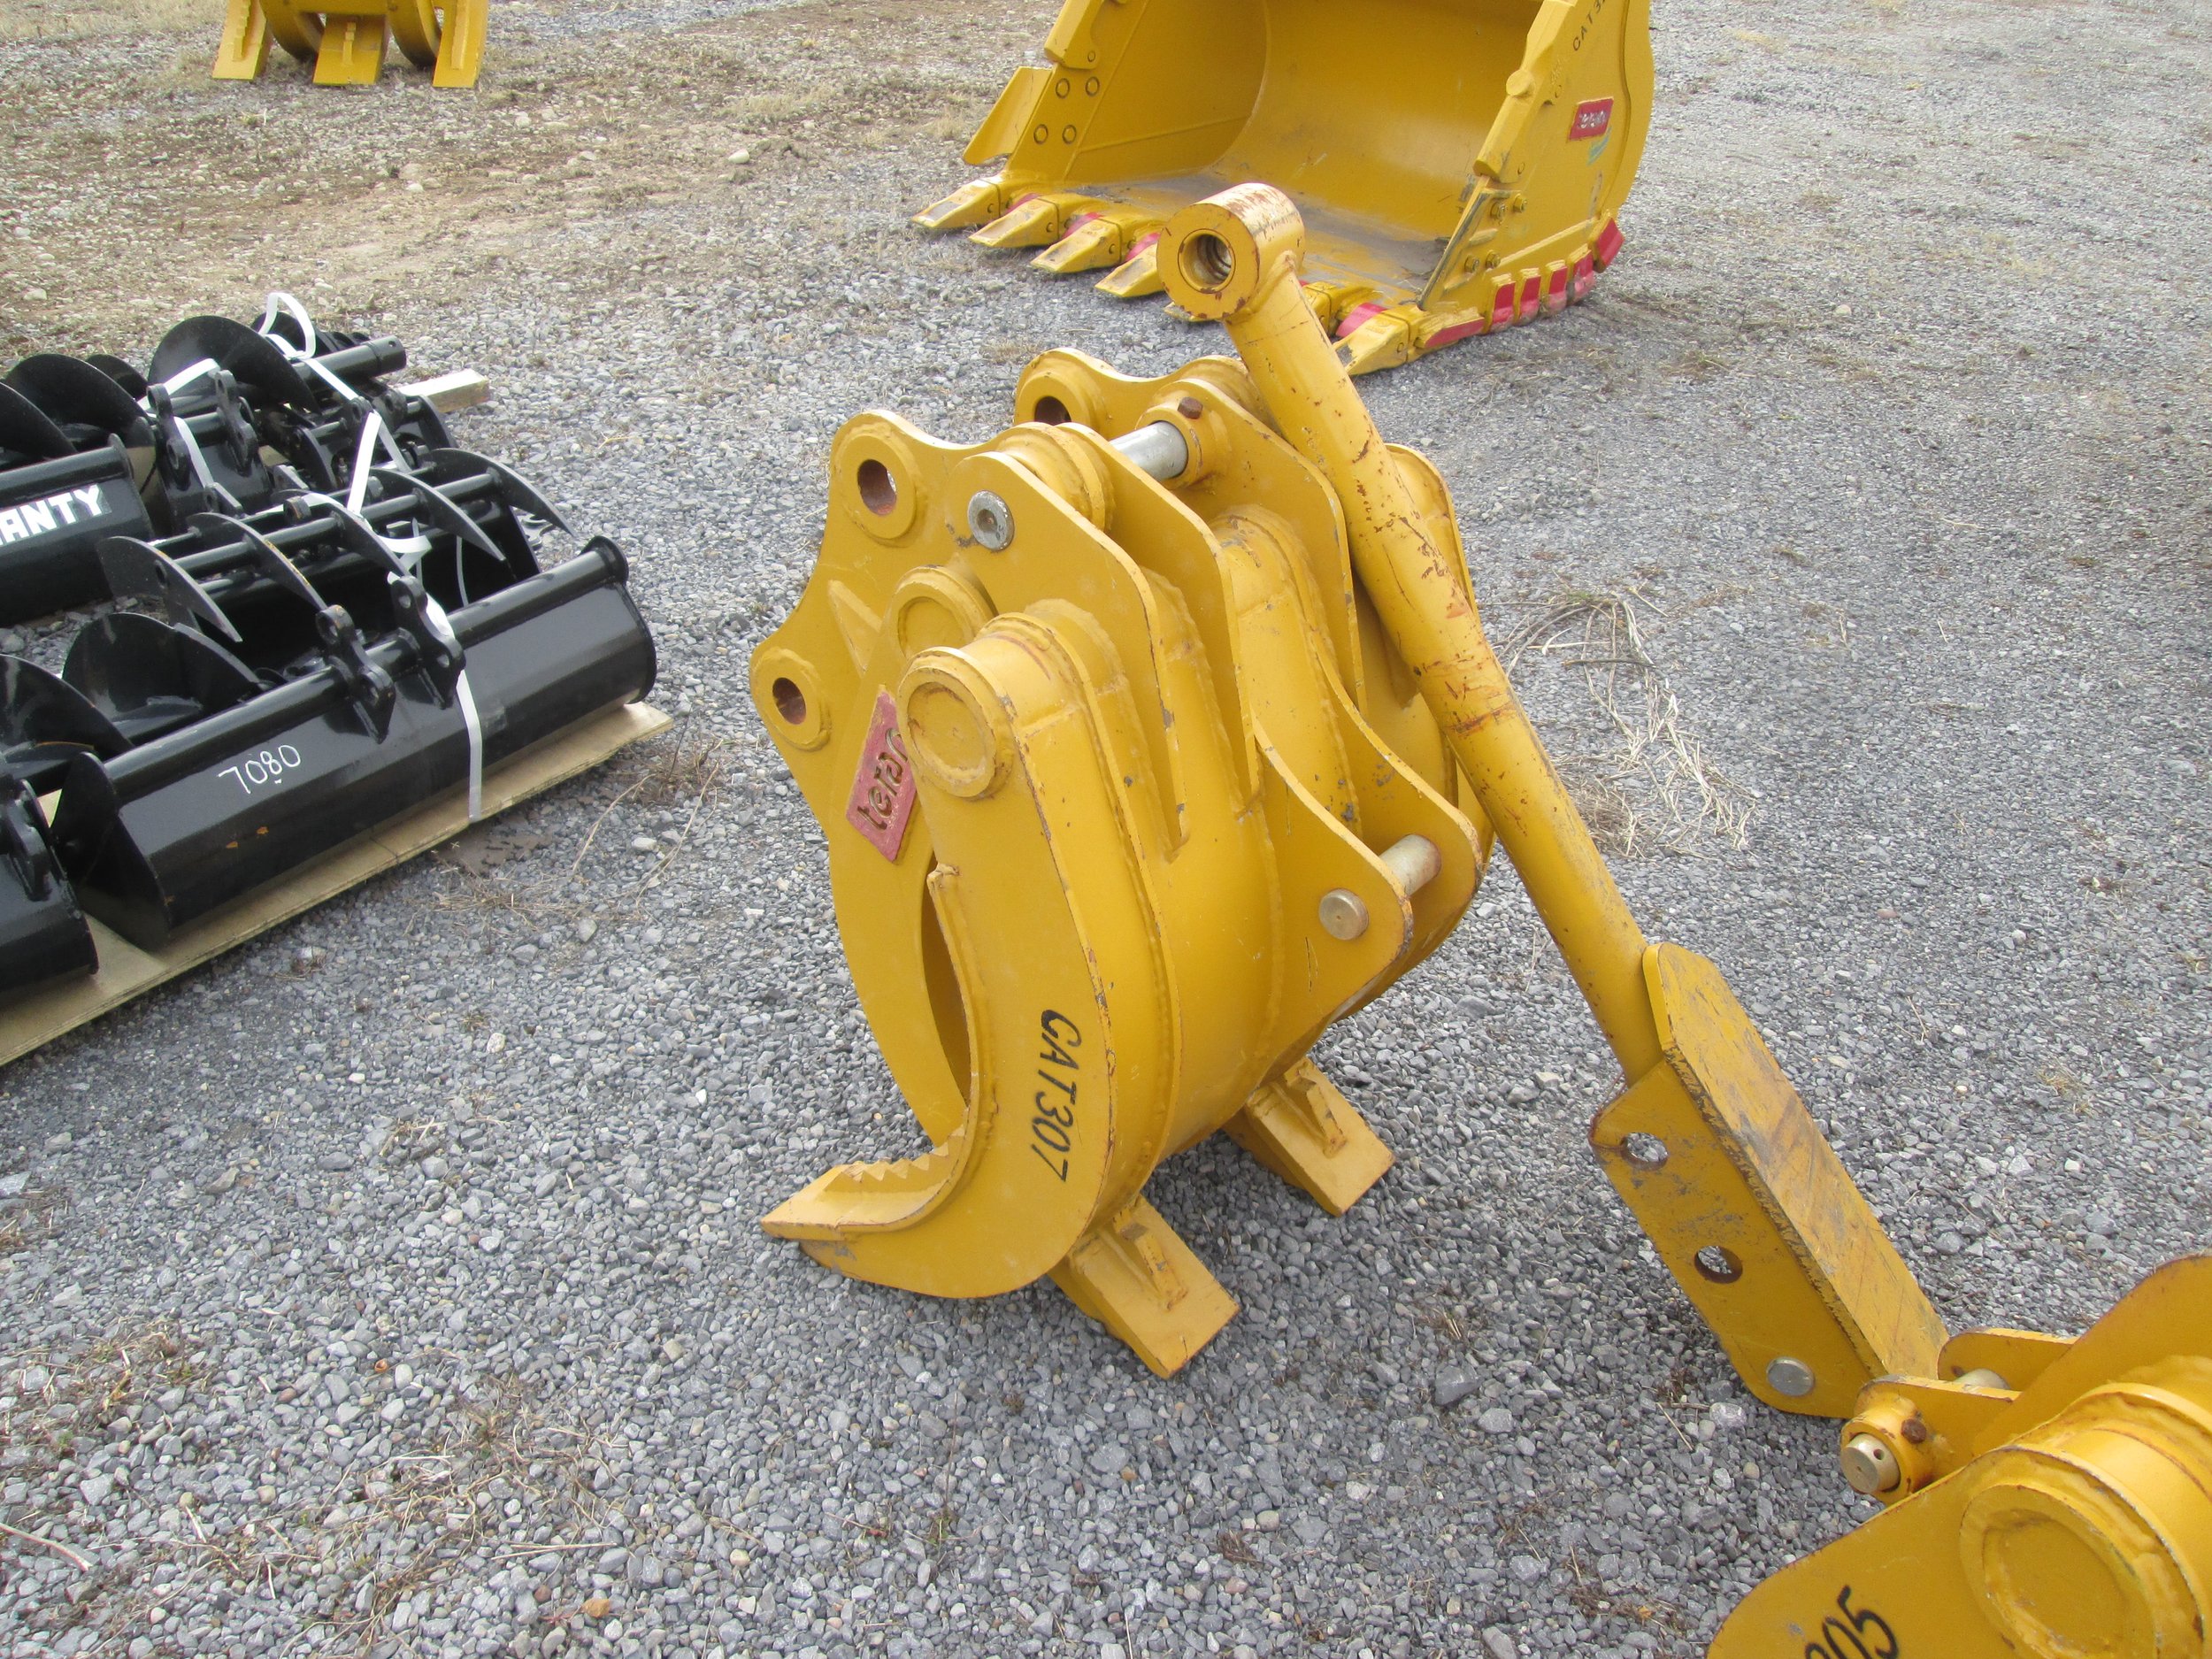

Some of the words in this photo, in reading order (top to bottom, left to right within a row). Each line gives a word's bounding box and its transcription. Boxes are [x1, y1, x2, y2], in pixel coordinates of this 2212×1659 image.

[0, 484, 103, 546] ANTY
[218, 745, 301, 794] 7080
[1031, 1009, 1082, 1182] CAT307
